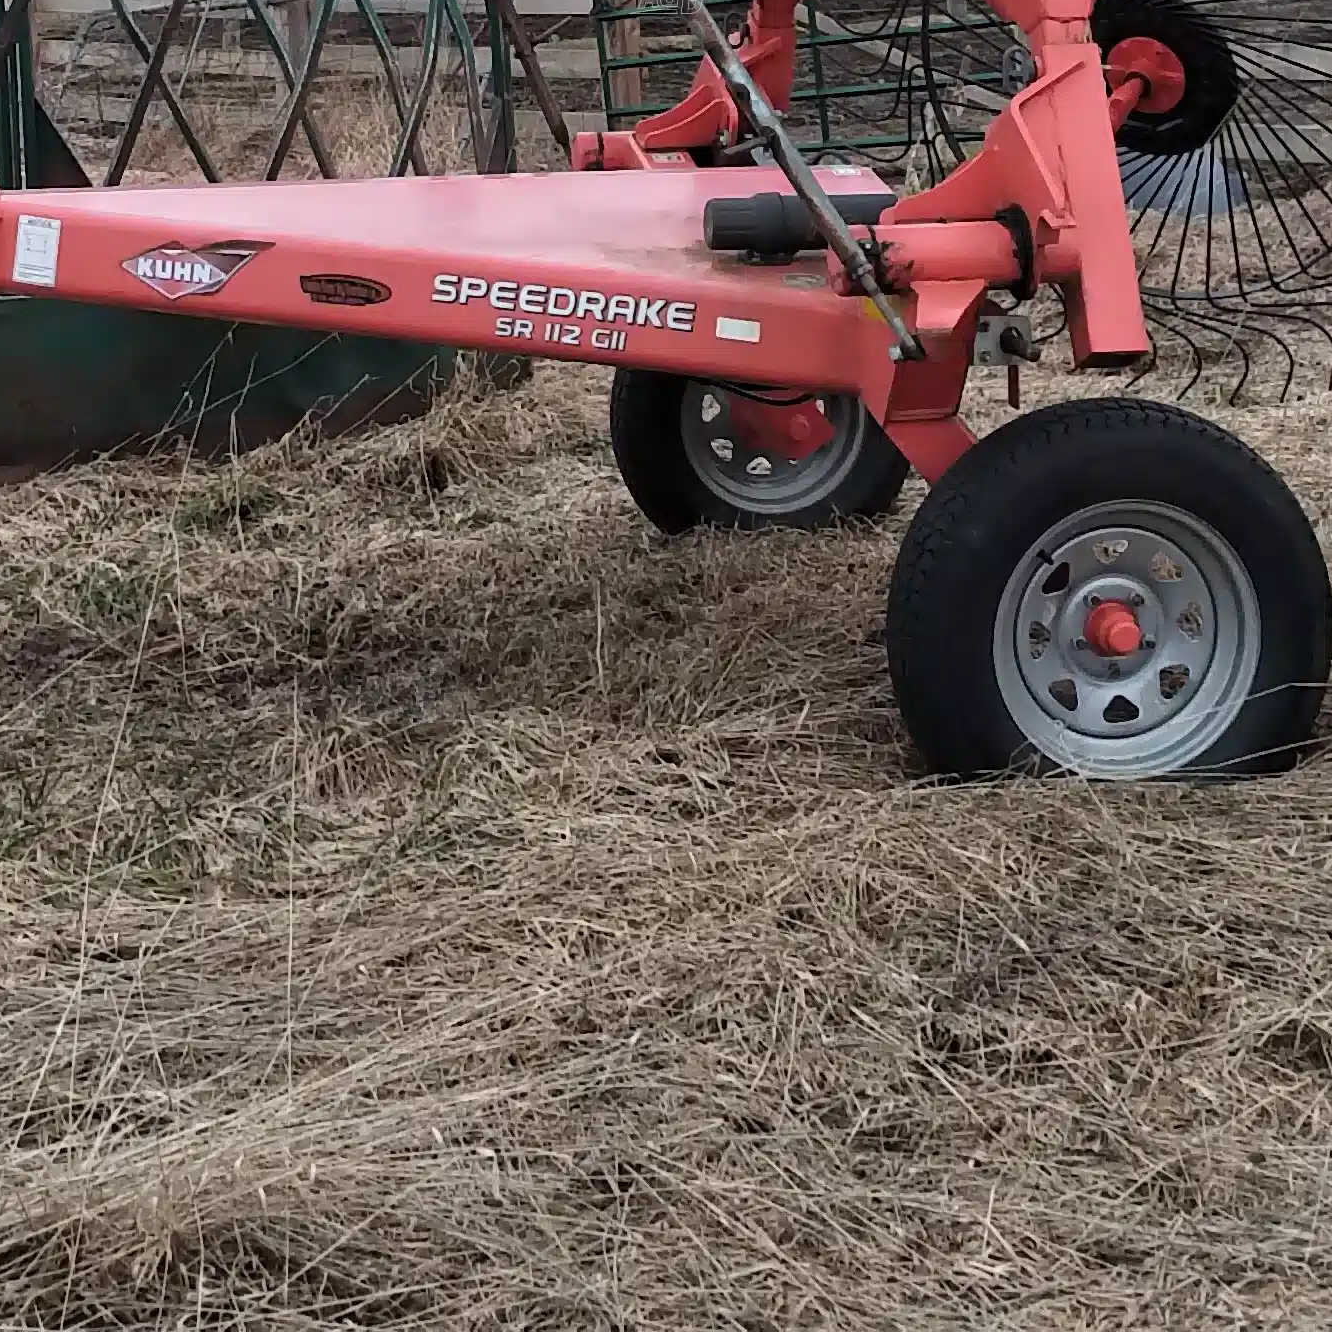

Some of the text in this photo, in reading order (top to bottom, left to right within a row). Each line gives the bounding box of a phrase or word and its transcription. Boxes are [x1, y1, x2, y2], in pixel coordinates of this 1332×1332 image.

[136, 256, 214, 284] KUHN
[431, 273, 697, 332] SPEEDRAKE
[494, 317, 628, 352] SR 112 GII
